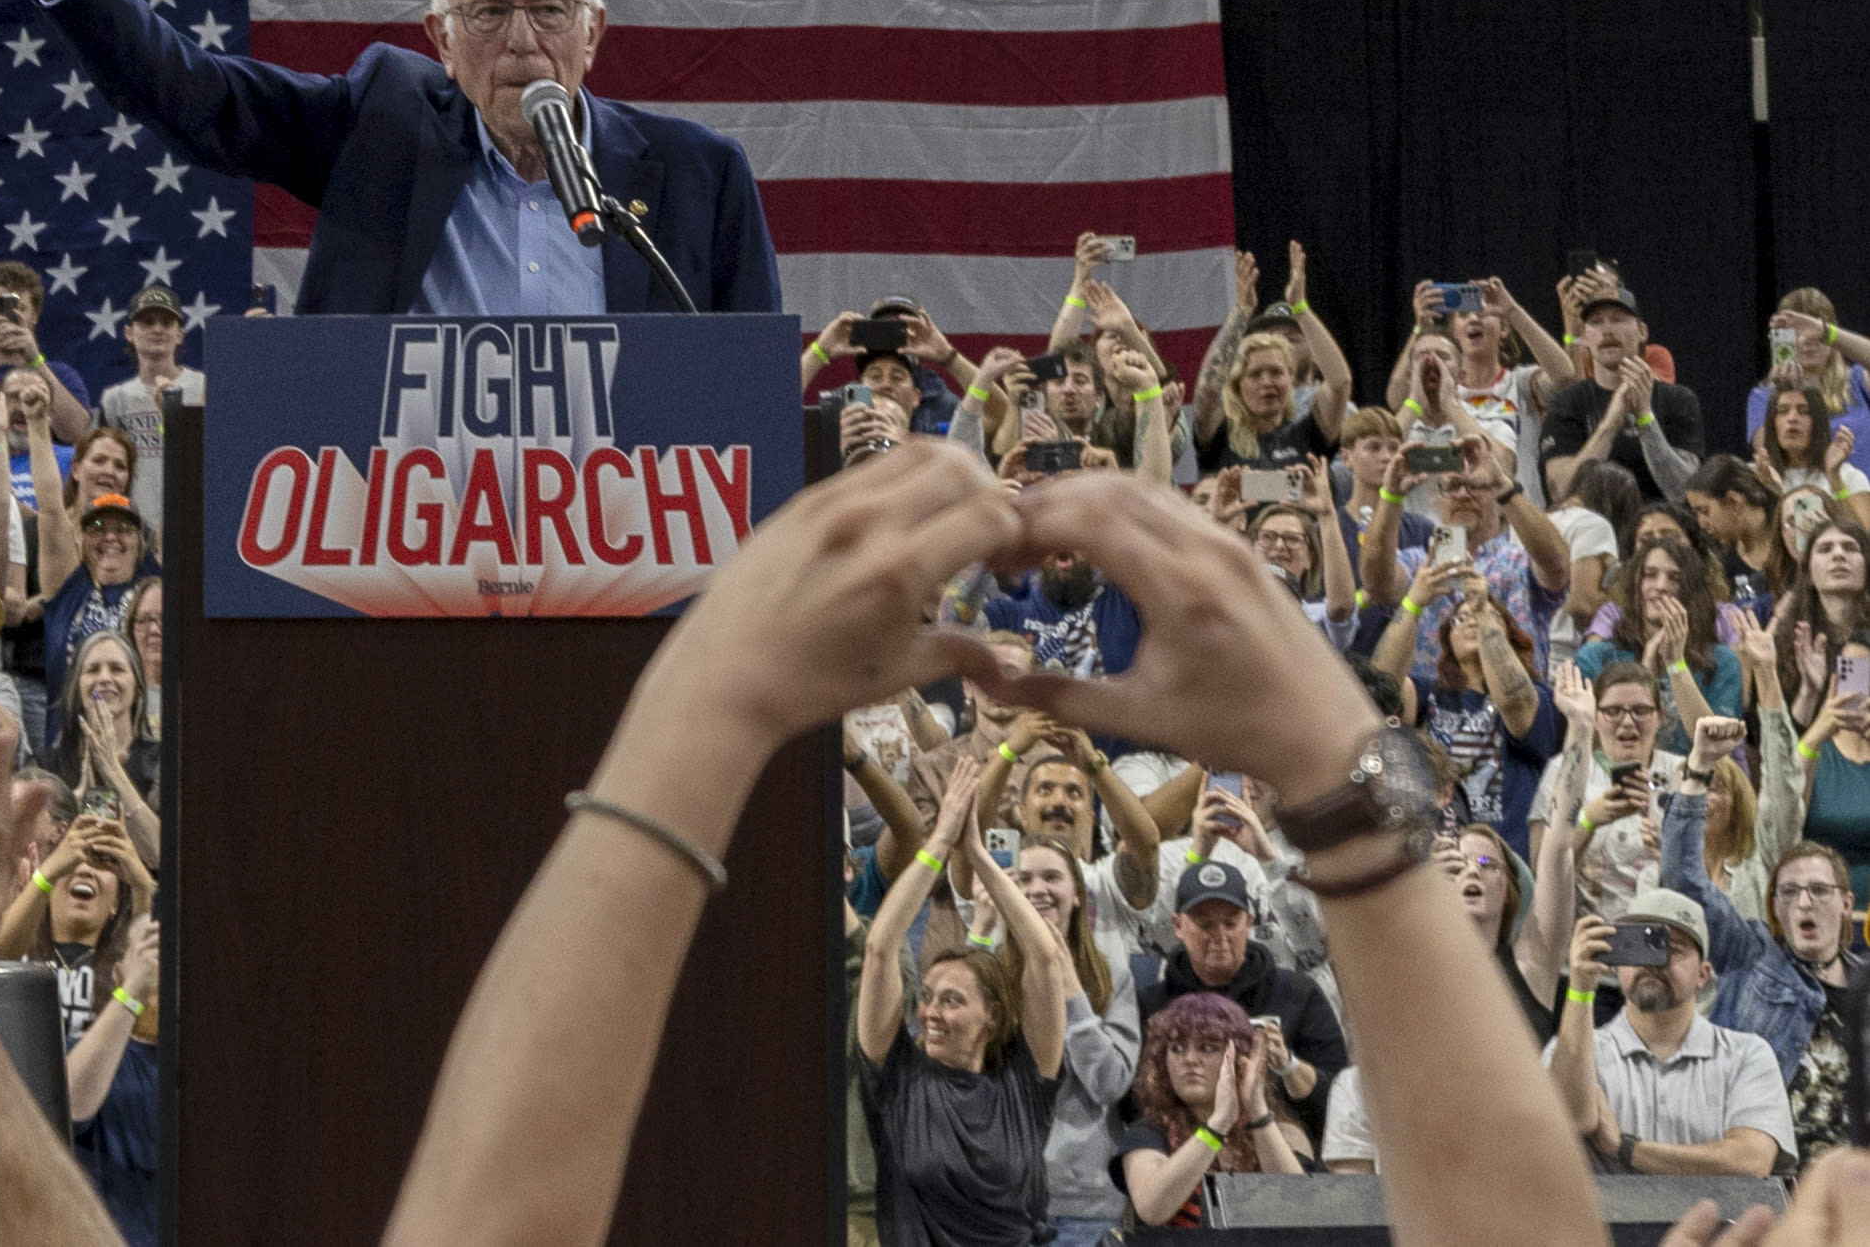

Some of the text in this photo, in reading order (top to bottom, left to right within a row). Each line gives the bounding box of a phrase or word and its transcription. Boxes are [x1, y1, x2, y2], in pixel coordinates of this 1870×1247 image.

[380, 323, 620, 438] FIGHT
[237, 445, 753, 567] OLIGARCHY
[478, 578, 534, 595] Bernie
